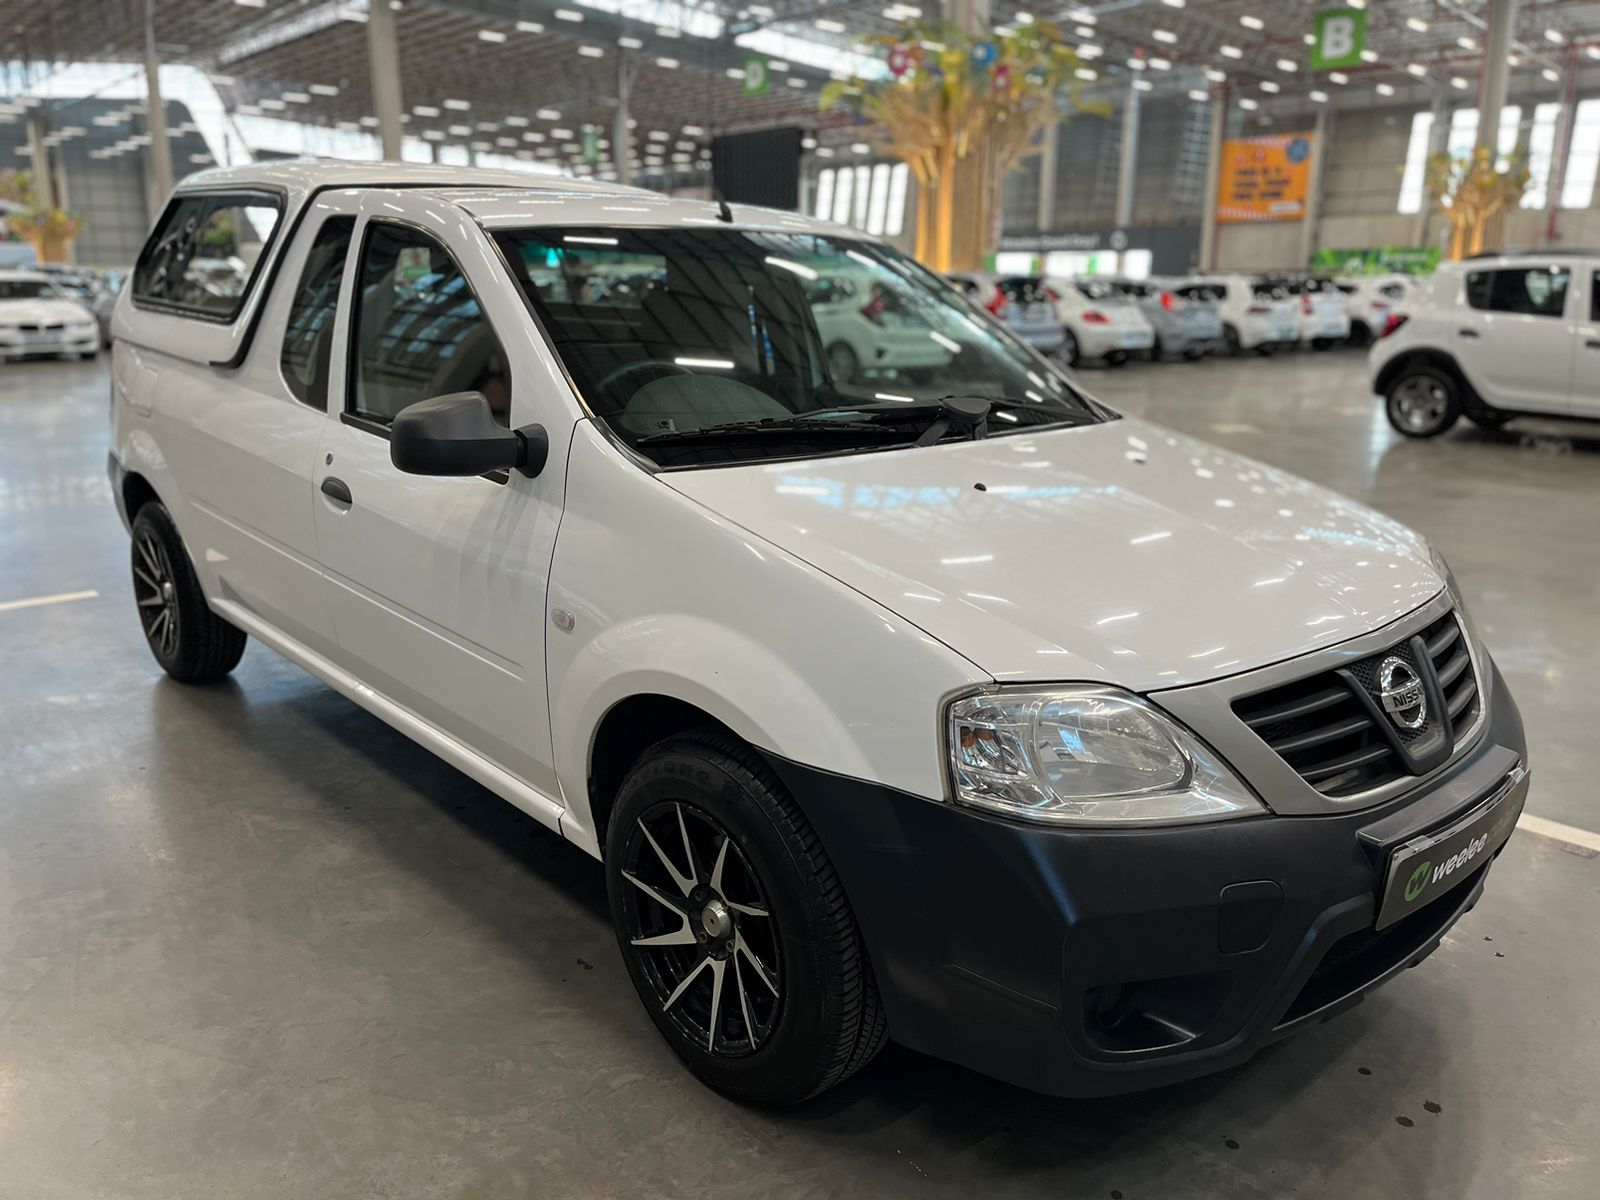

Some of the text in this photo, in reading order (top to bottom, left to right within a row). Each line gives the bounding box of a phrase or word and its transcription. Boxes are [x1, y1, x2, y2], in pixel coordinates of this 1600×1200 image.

[1319, 16, 1356, 60] B
[1392, 686, 1423, 708] NISS
[1432, 832, 1488, 884] weelee
